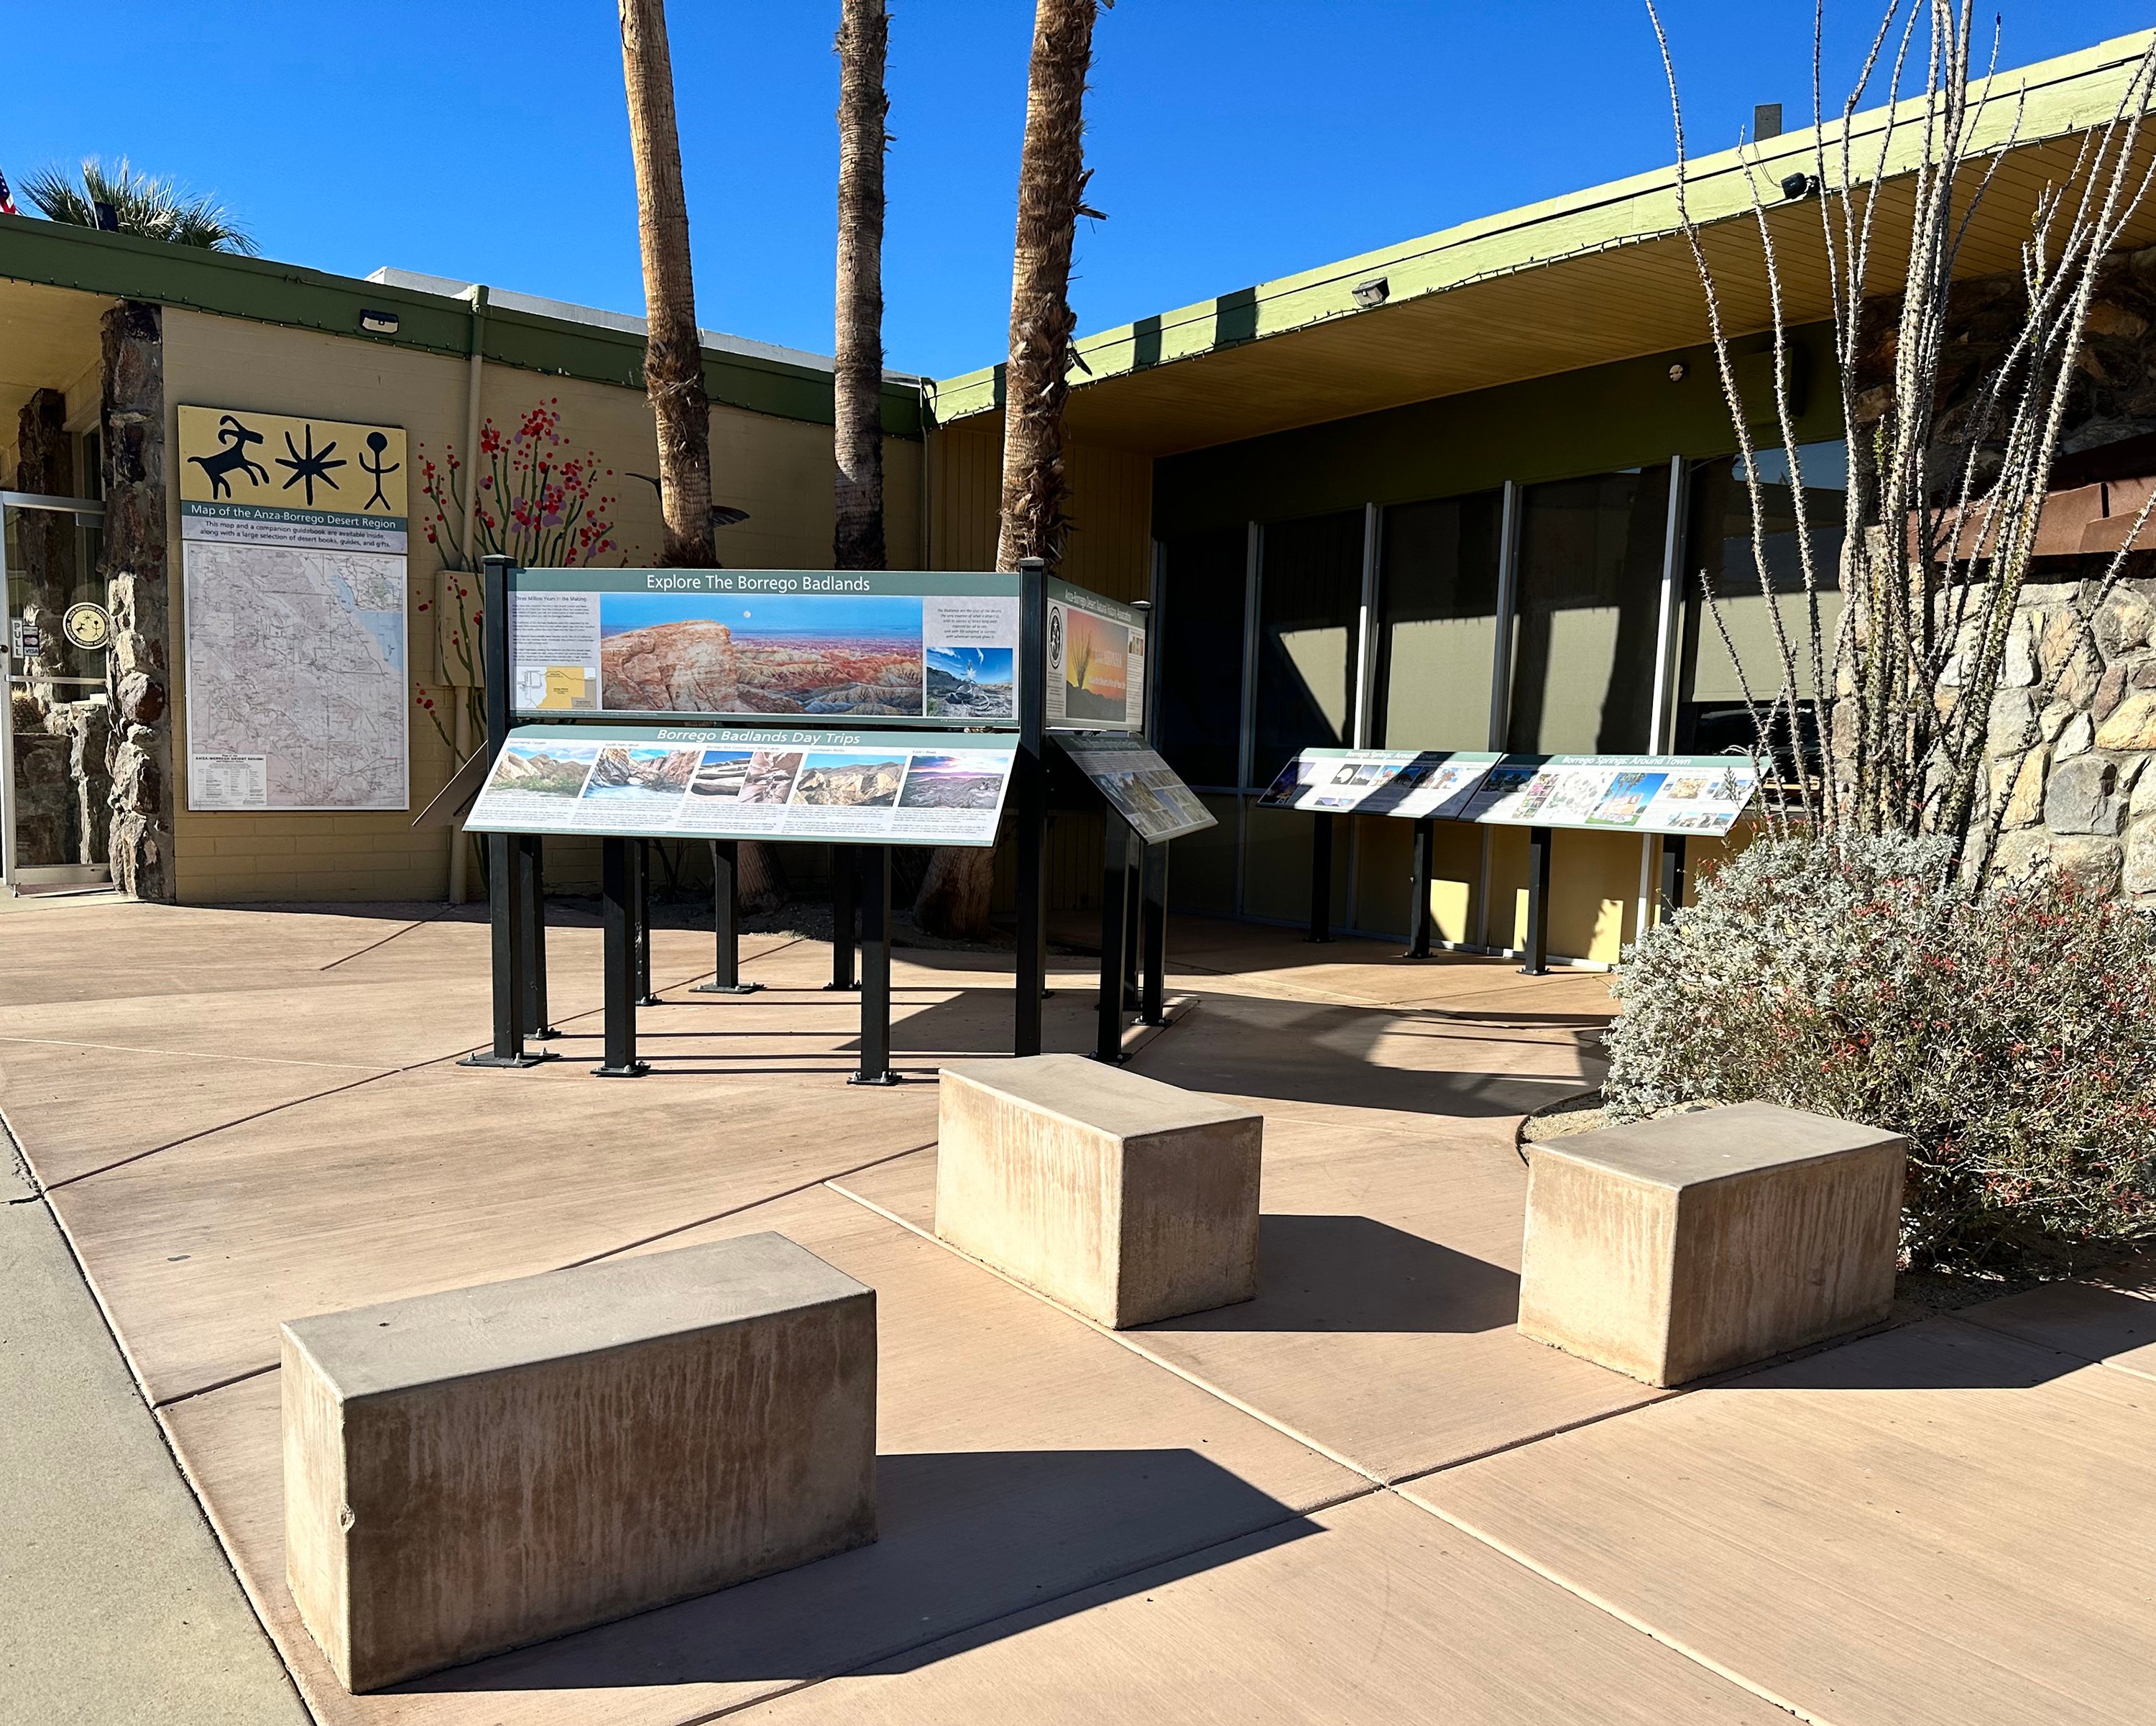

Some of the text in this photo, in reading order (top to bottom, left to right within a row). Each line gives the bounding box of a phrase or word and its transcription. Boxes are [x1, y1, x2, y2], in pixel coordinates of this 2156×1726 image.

[191, 505, 396, 529] Map of the Anza-Borrego Desert Region
[242, 531, 259, 539] large
[647, 575, 870, 593] Explore The Borrego Badlands
[657, 729, 860, 745] Borrego Badlands Day Trips
[1345, 750, 1369, 759] Borrego
[1561, 756, 1692, 766] Borrego Springs: Around Town
